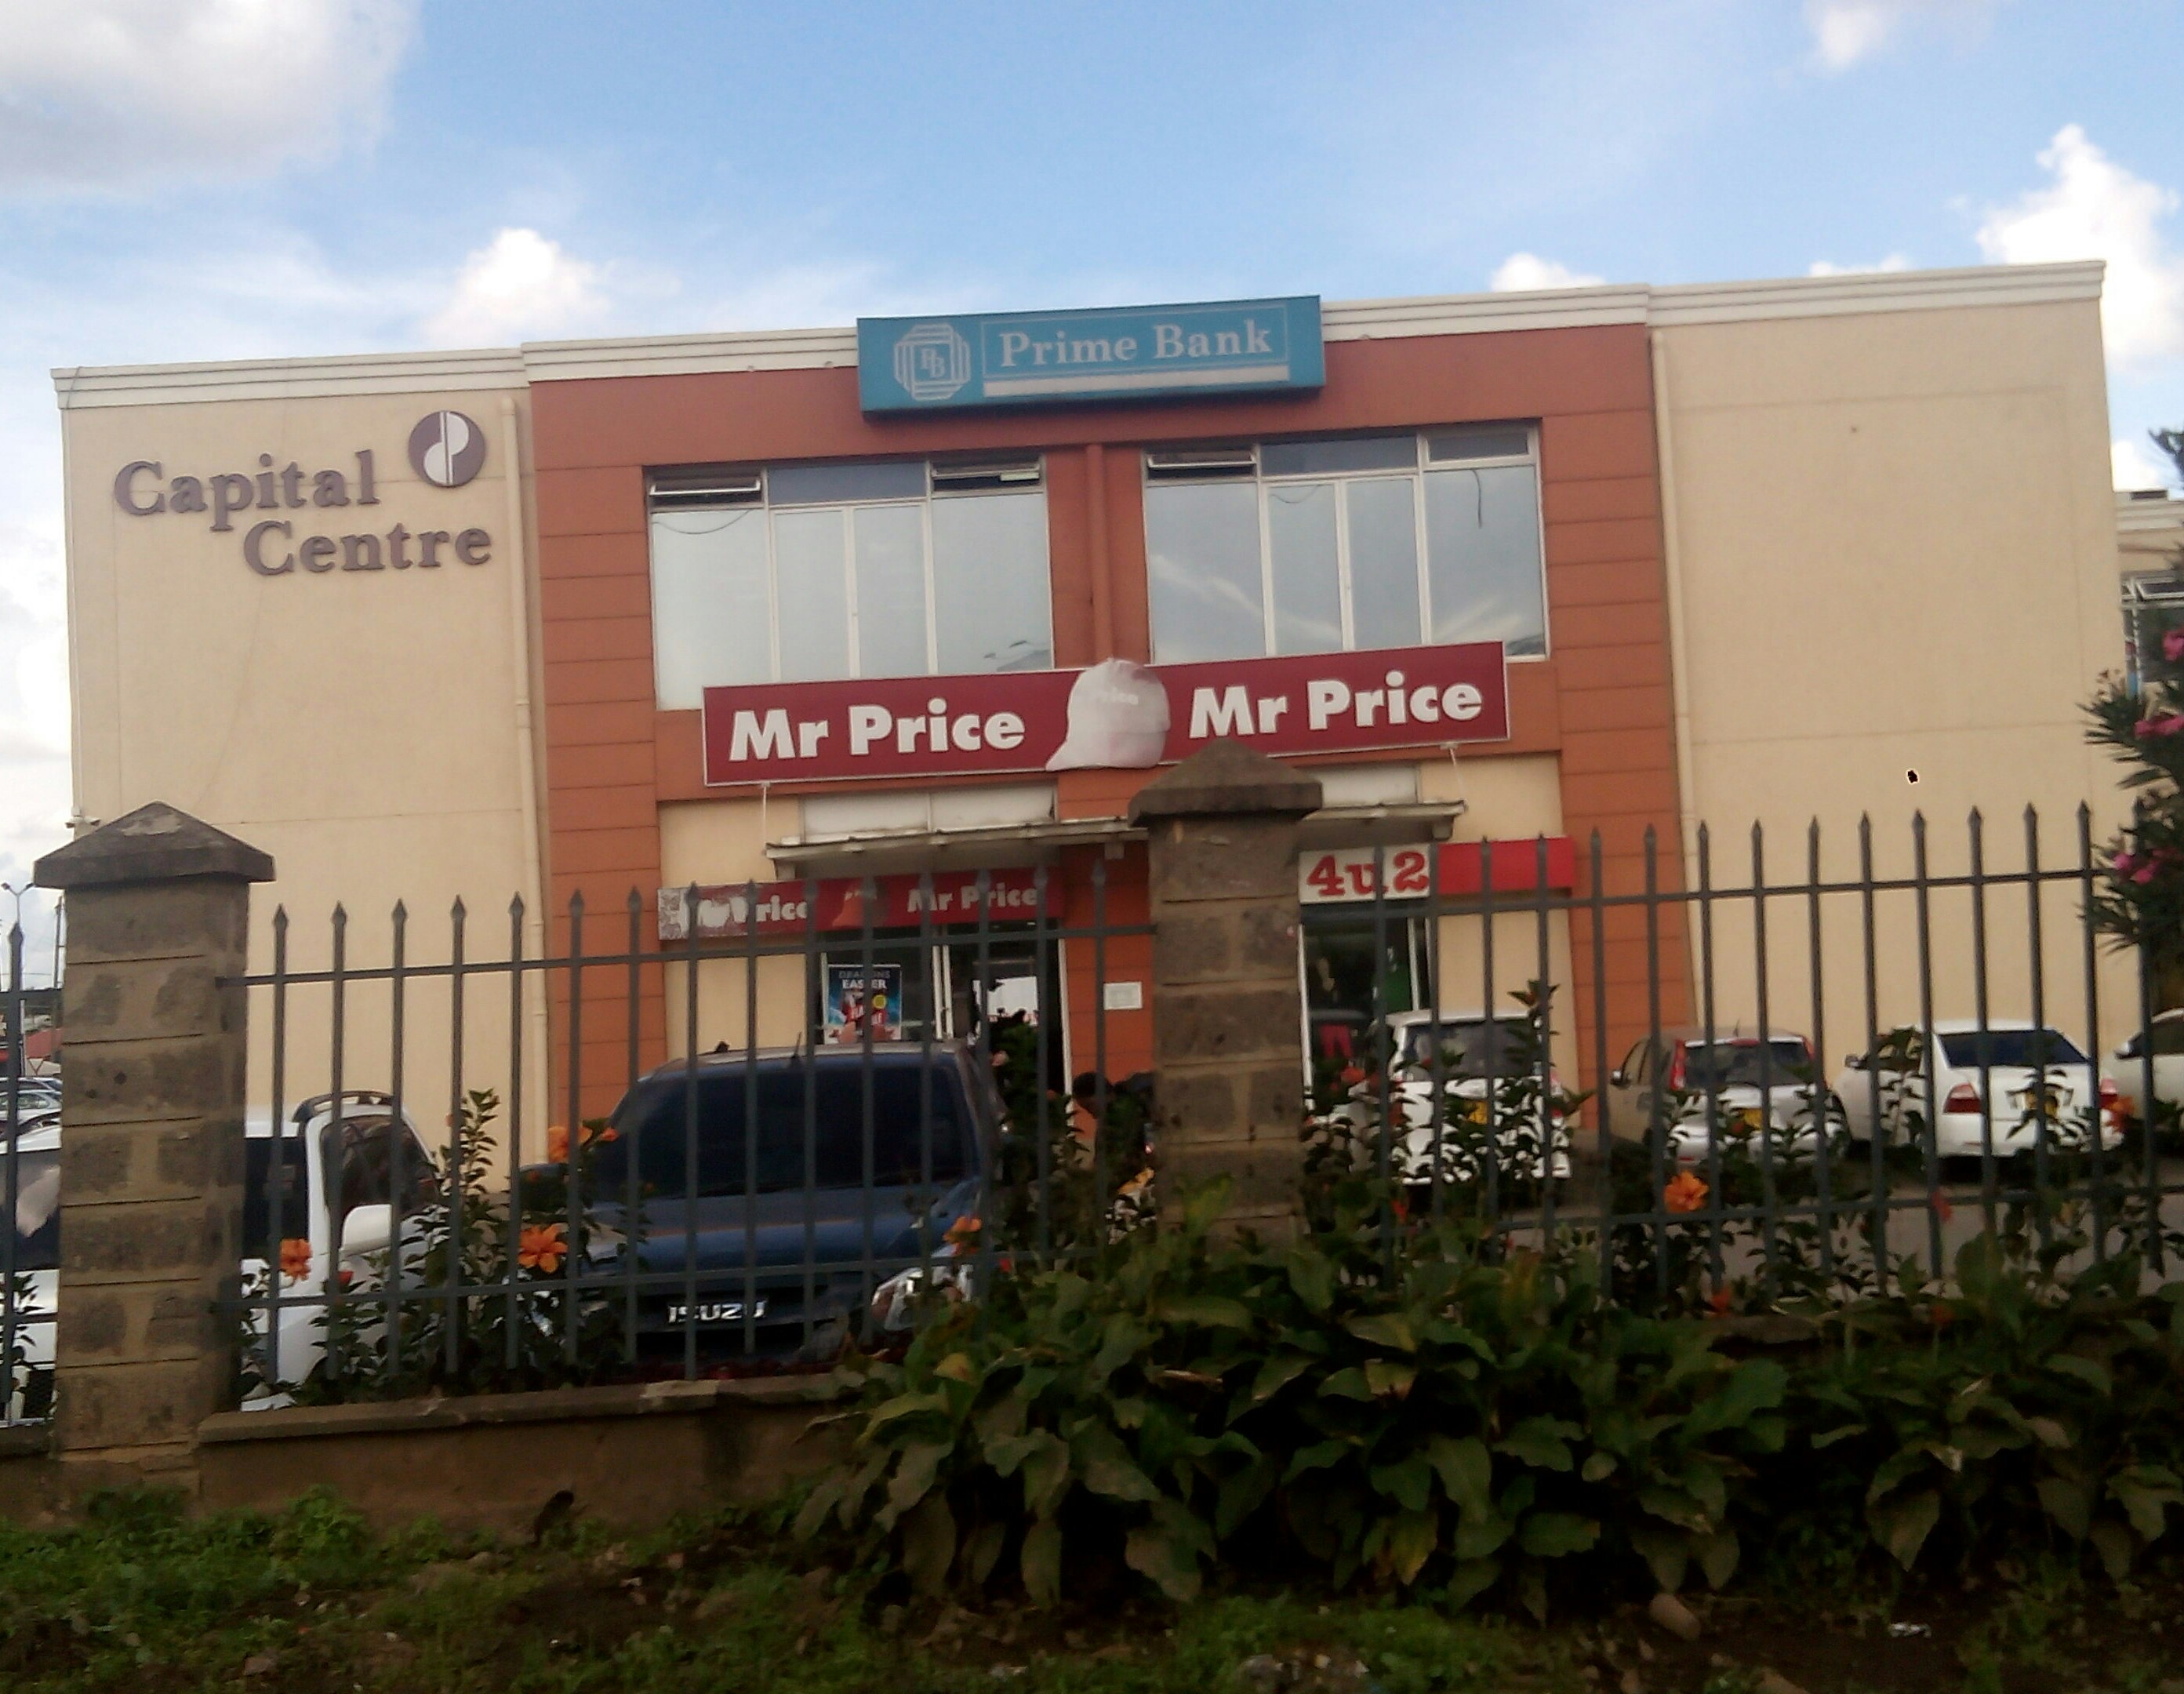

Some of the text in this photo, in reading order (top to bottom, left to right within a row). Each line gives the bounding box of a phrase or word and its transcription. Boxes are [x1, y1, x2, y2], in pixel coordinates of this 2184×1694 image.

[998, 319, 1273, 367] Prime Bank
[114, 449, 380, 532] Capital
[243, 520, 492, 576] Centre
[729, 696, 1026, 762] Mr Price
[1189, 670, 1483, 739] Mr Price
[907, 882, 1037, 913] Mr Price
[841, 979, 888, 990] EASER
